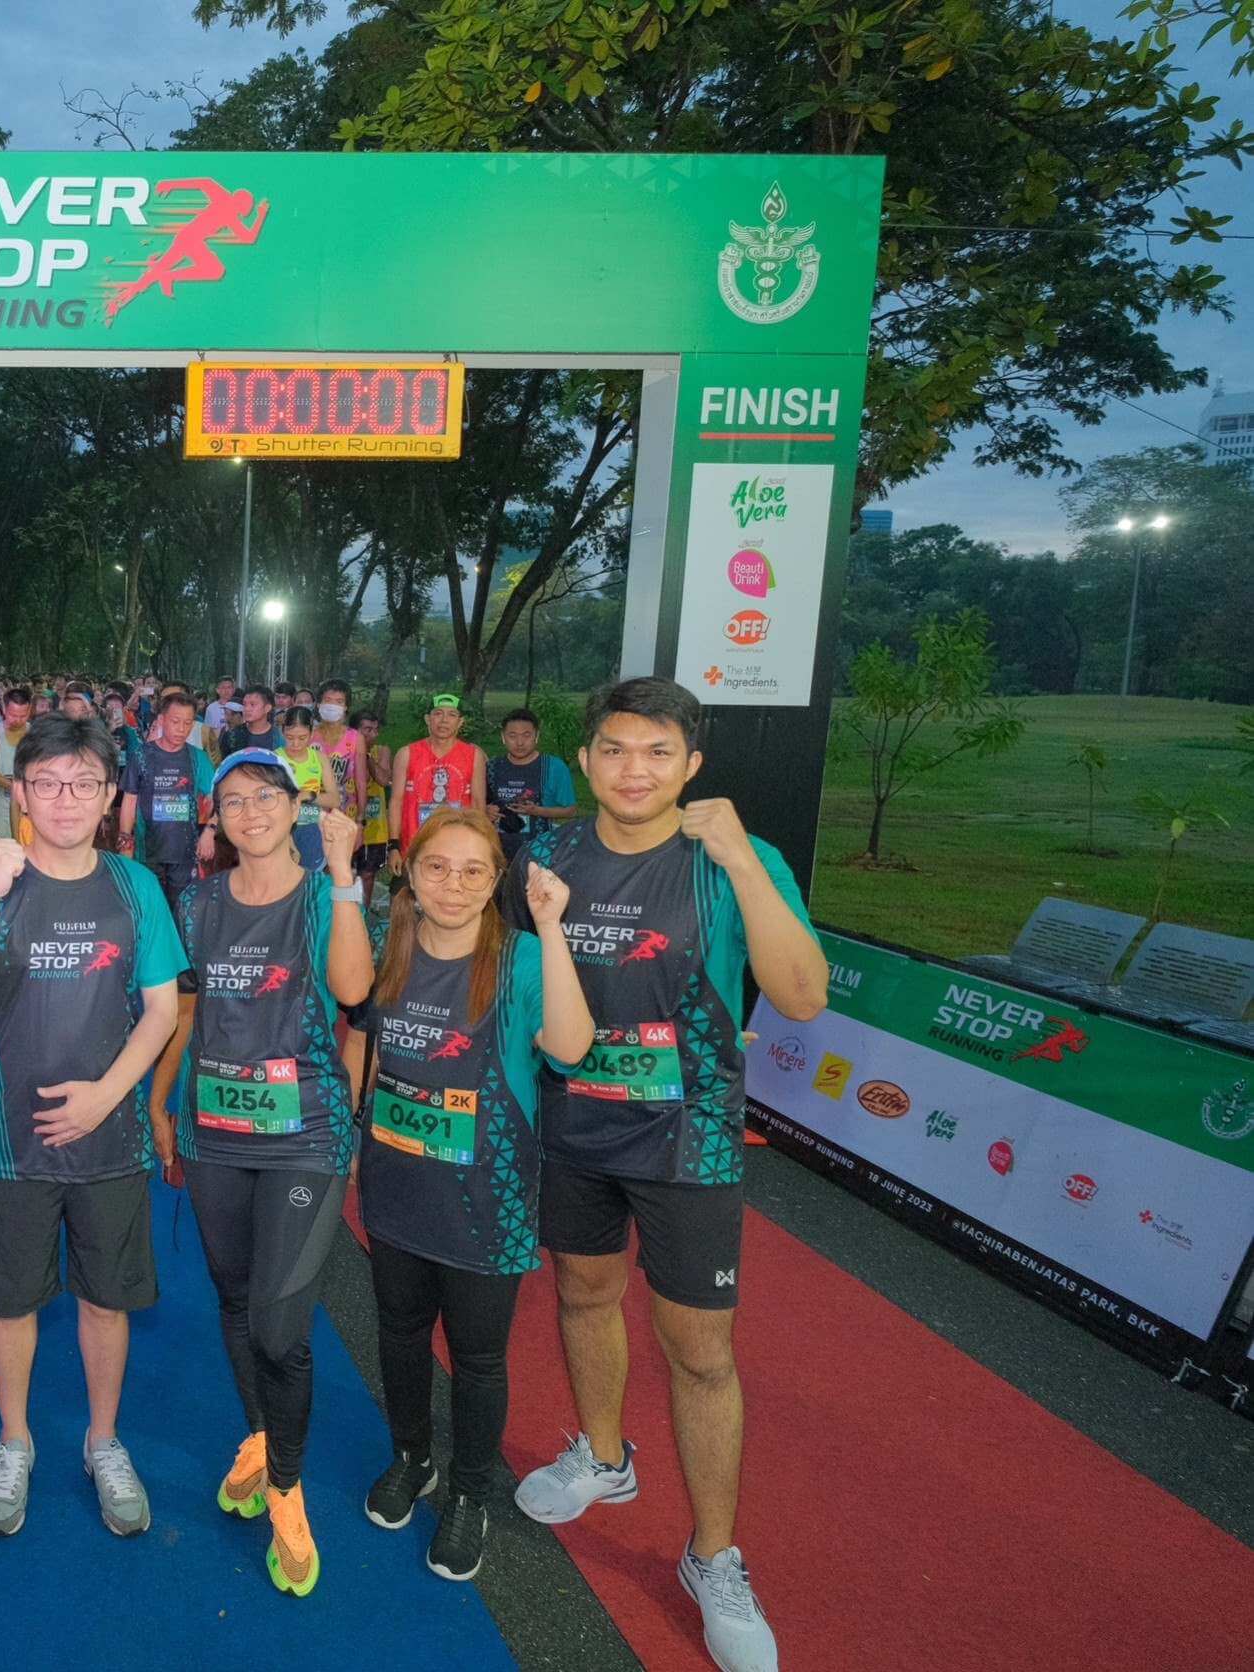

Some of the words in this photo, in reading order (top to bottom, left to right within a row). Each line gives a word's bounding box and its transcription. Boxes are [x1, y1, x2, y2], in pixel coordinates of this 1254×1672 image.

[203, 368, 446, 434] 00:00:00
[700, 387, 839, 426] FINISH
[257, 438, 339, 452] Shutter
[348, 438, 443, 454] Running
[730, 476, 785, 507] Aloe
[736, 504, 788, 528] Vera
[735, 574, 761, 585] Drink
[723, 617, 771, 640] OFF!
[590, 903, 642, 915] FUJIFILM
[54, 921, 96, 931] FUJIFILM
[30, 941, 94, 954] NEVER
[229, 945, 269, 954] FUJIFILM
[566, 939, 617, 955] TOP
[29, 956, 81, 969] STOP
[207, 963, 263, 977] NEVER
[30, 970, 81, 979] RUNNING
[206, 977, 251, 990] STOP
[206, 990, 251, 999] RUNNING
[406, 1001, 450, 1017] FUJIFILM
[944, 984, 1045, 1031] NEVER
[383, 1016, 443, 1041] NEVER
[933, 1006, 1013, 1042] STOP
[381, 1031, 426, 1050] STOP
[647, 1027, 670, 1041] 4K
[928, 1026, 1004, 1062] RUNNING
[272, 1064, 291, 1079] 4K
[582, 1052, 658, 1076] 0489
[215, 1085, 276, 1111] 1254
[450, 1095, 471, 1109] 2K
[389, 1103, 452, 1138] 0491
[925, 1109, 957, 1130] Aloe
[926, 1124, 956, 1140] Vera
[770, 1114, 793, 1135] NEVER
[793, 1130, 815, 1147] STOP
[816, 1143, 855, 1170] RUNNING
[868, 1171, 879, 1182] 18
[880, 1180, 906, 1198] JUNE
[906, 1193, 933, 1213] 2023
[952, 1218, 1077, 1292] @VACHIRABENJATAS
[1079, 1287, 1121, 1318] PARK,
[1127, 1313, 1161, 1338] BKK
